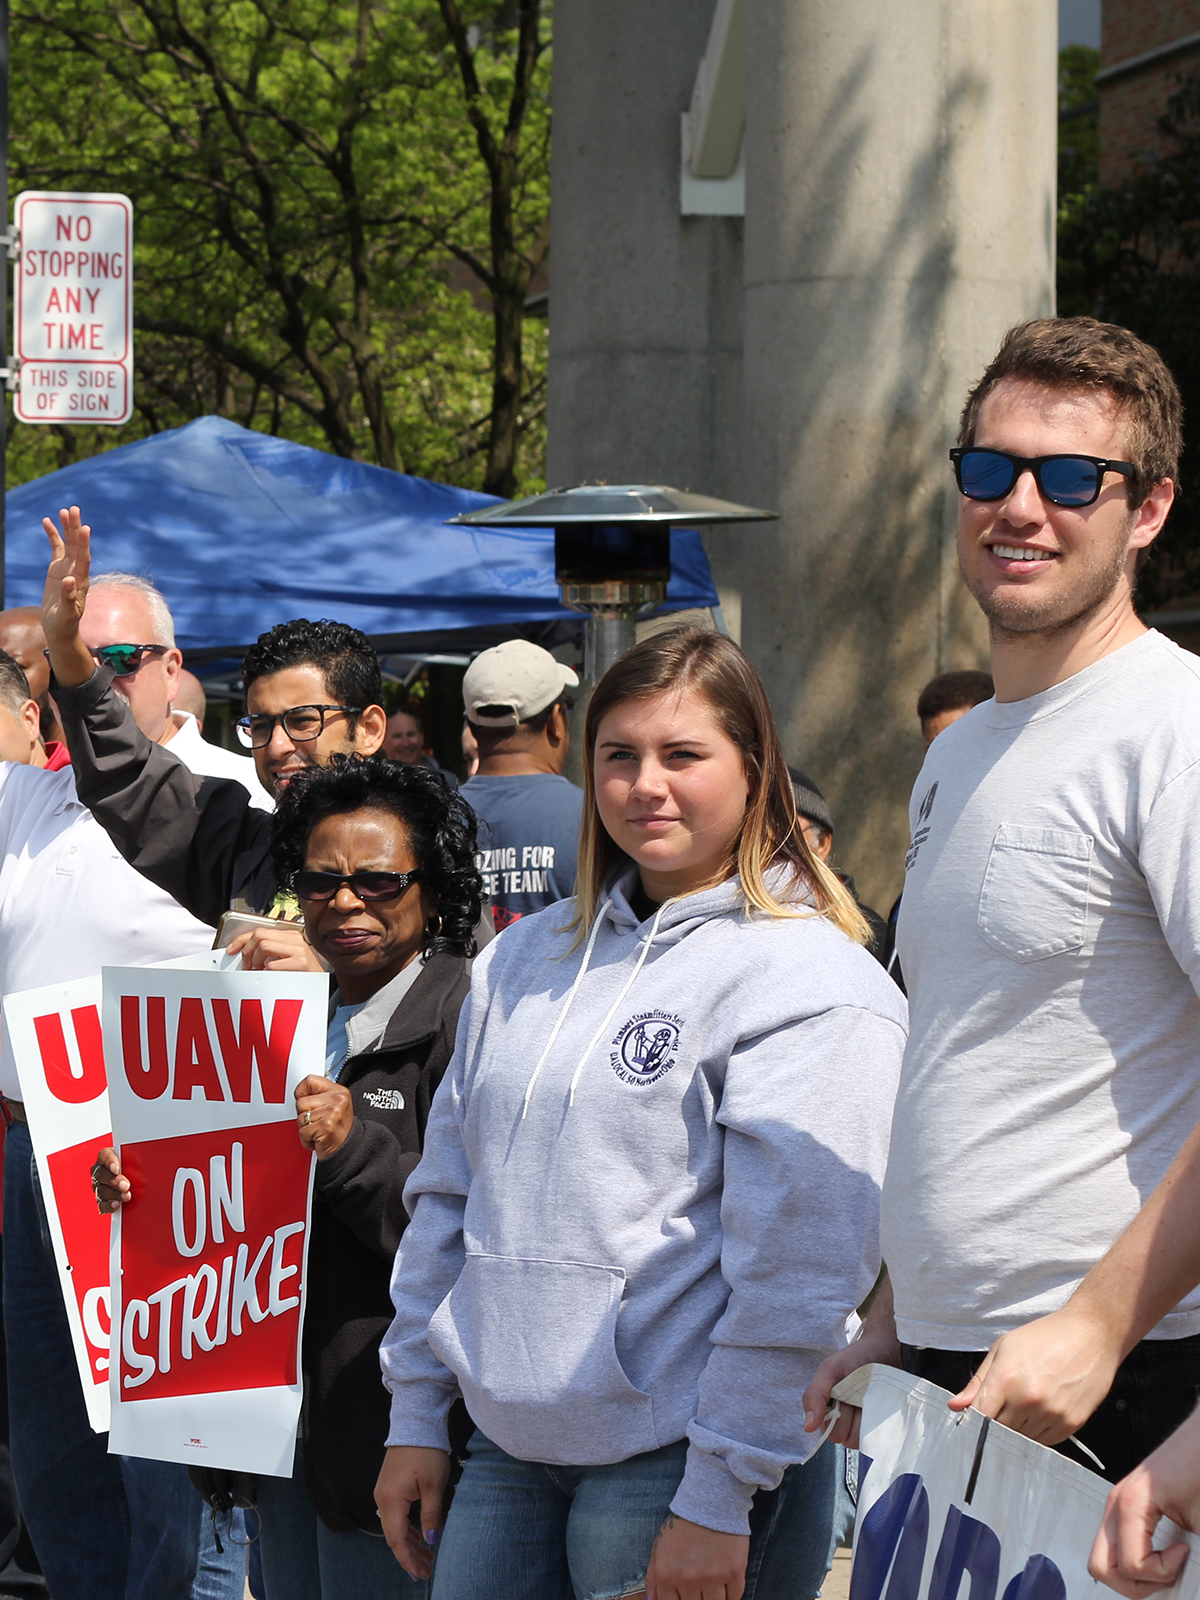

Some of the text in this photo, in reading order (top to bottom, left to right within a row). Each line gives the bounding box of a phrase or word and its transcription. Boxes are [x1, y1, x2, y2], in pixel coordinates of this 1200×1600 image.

[56, 215, 92, 242] NO
[25, 250, 123, 279] STOPPING
[46, 287, 101, 314] ANY
[43, 323, 104, 350] TIME
[30, 369, 117, 388] THIS SIDE
[36, 393, 109, 411] OF SIGN
[522, 846, 555, 869] FOR
[502, 870, 549, 894] TEAM
[611, 1018, 634, 1045] Plumbers
[120, 995, 304, 1104] UAW
[362, 1092, 392, 1102] NORTH
[370, 1101, 392, 1110] FACE
[377, 1088, 394, 1097] THE
[171, 1142, 245, 1258] ON
[122, 1221, 305, 1388] STRIKE
